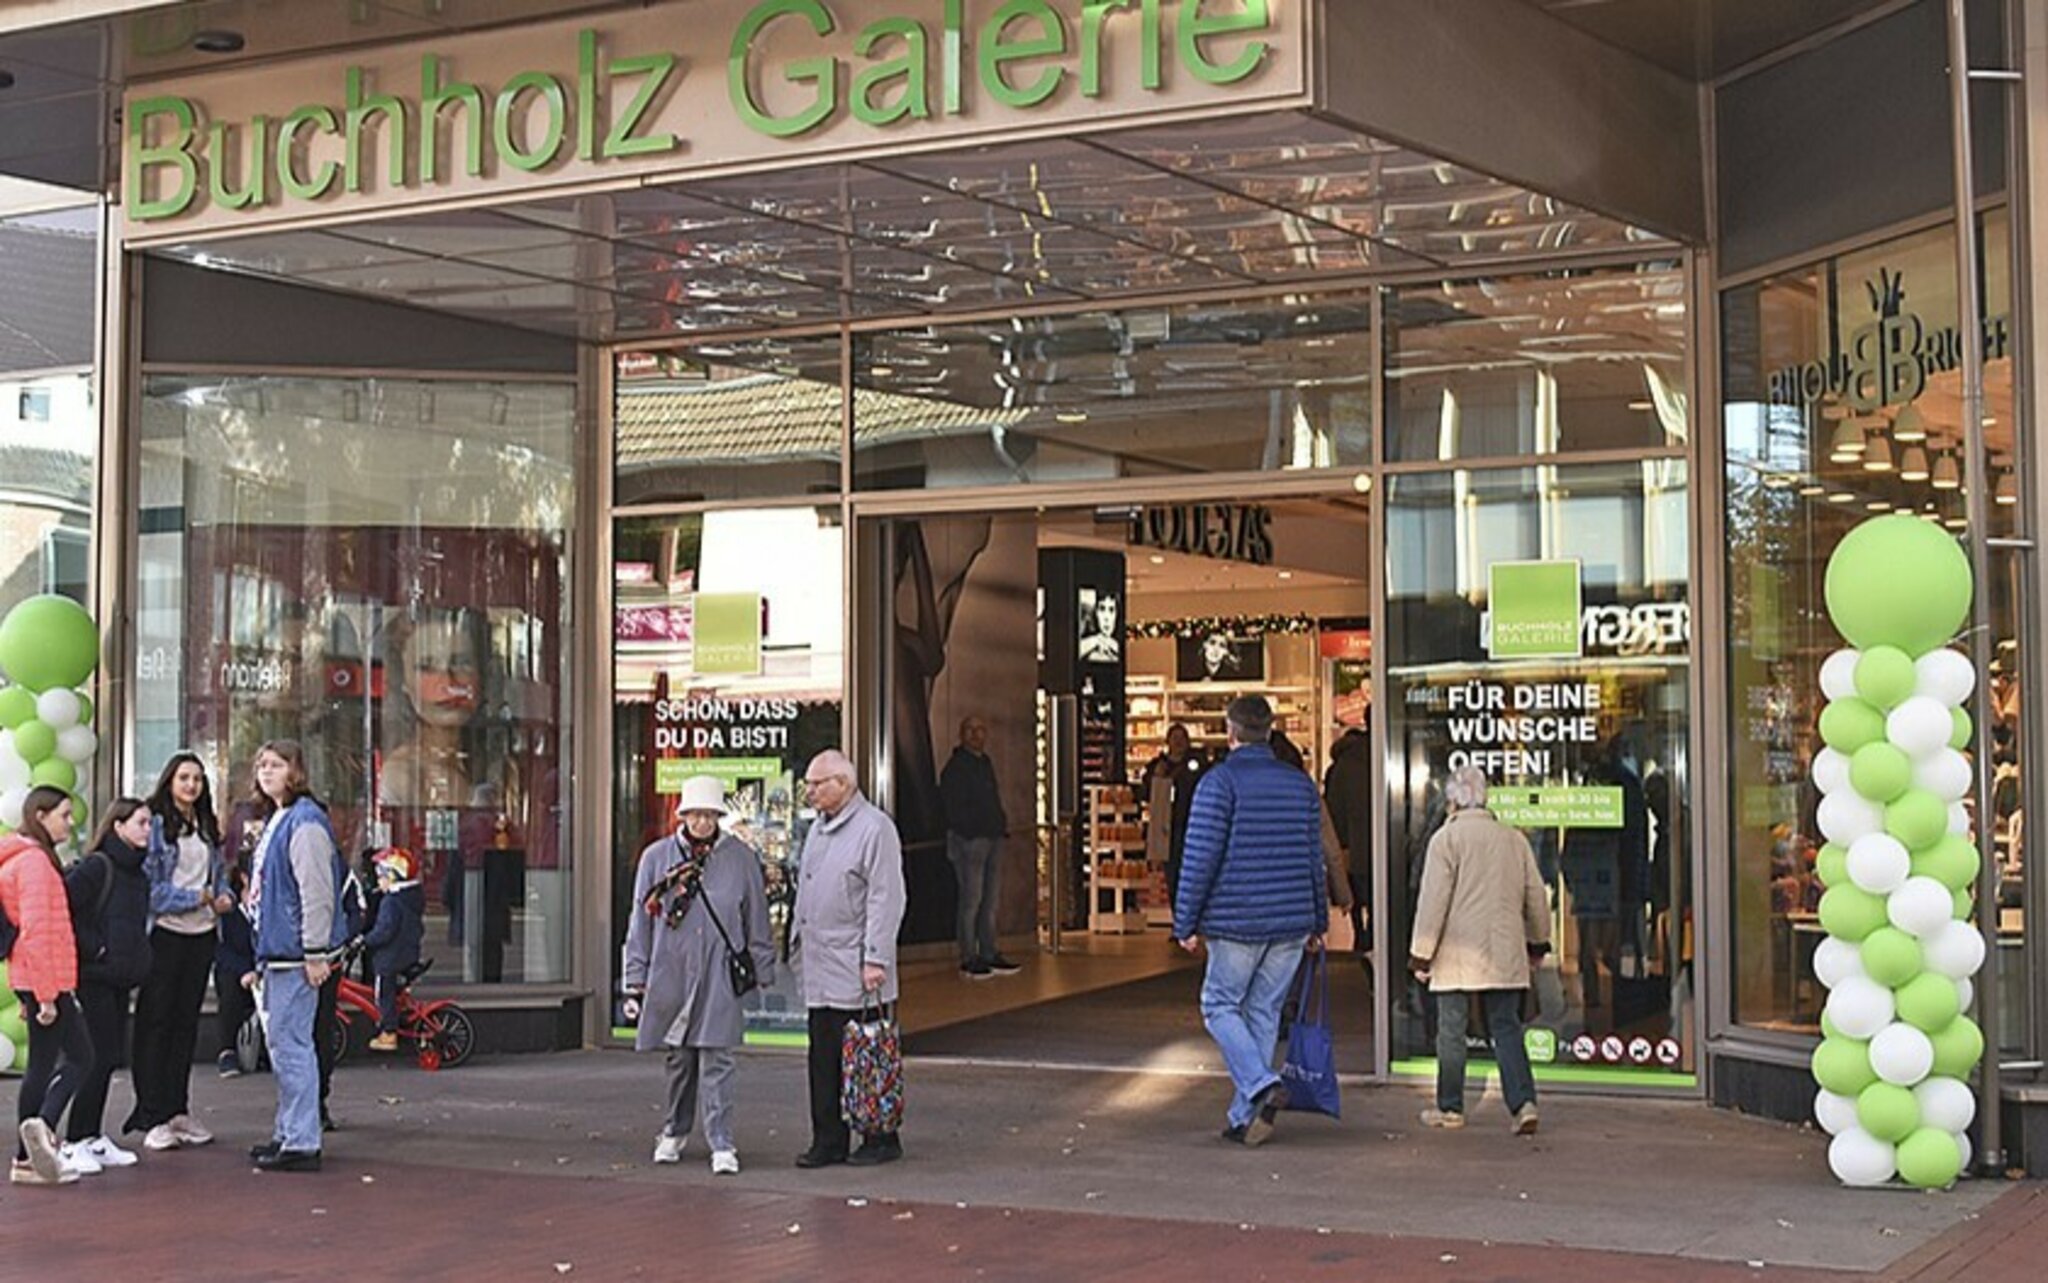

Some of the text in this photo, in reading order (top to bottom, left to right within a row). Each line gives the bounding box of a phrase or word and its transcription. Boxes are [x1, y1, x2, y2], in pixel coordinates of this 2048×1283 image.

[129, 0, 1270, 221] Buchholz Galerie
[1448, 680, 1506, 710] FÜR
[1513, 684, 1601, 710] DEINE
[740, 698, 798, 720] DASS
[655, 727, 787, 748] DU DA BIST!
[1448, 714, 1597, 742] WÜNSCHE
[1448, 750, 1550, 775] OFFEN!
